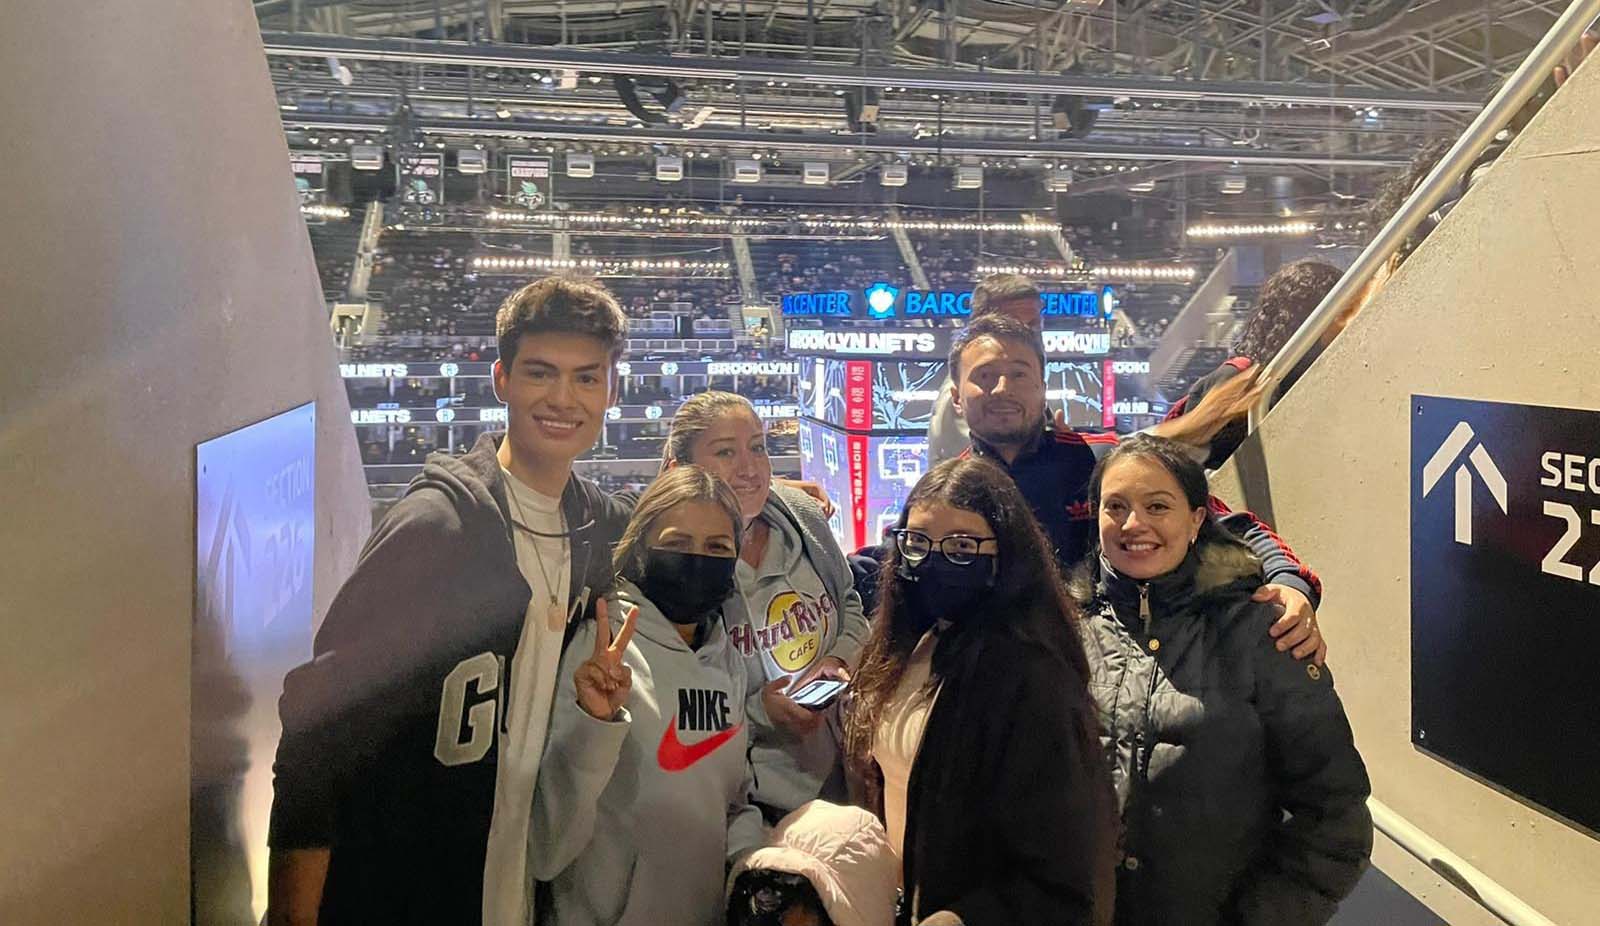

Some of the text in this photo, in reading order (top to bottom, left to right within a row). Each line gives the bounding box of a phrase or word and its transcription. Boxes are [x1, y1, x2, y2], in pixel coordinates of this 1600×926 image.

[793, 293, 851, 315] CENTER
[906, 291, 974, 316] BARC
[869, 333, 935, 353] NETS
[708, 362, 791, 375] BROOKLYN
[789, 638, 825, 661] CAFE
[678, 688, 733, 731] NIKE
